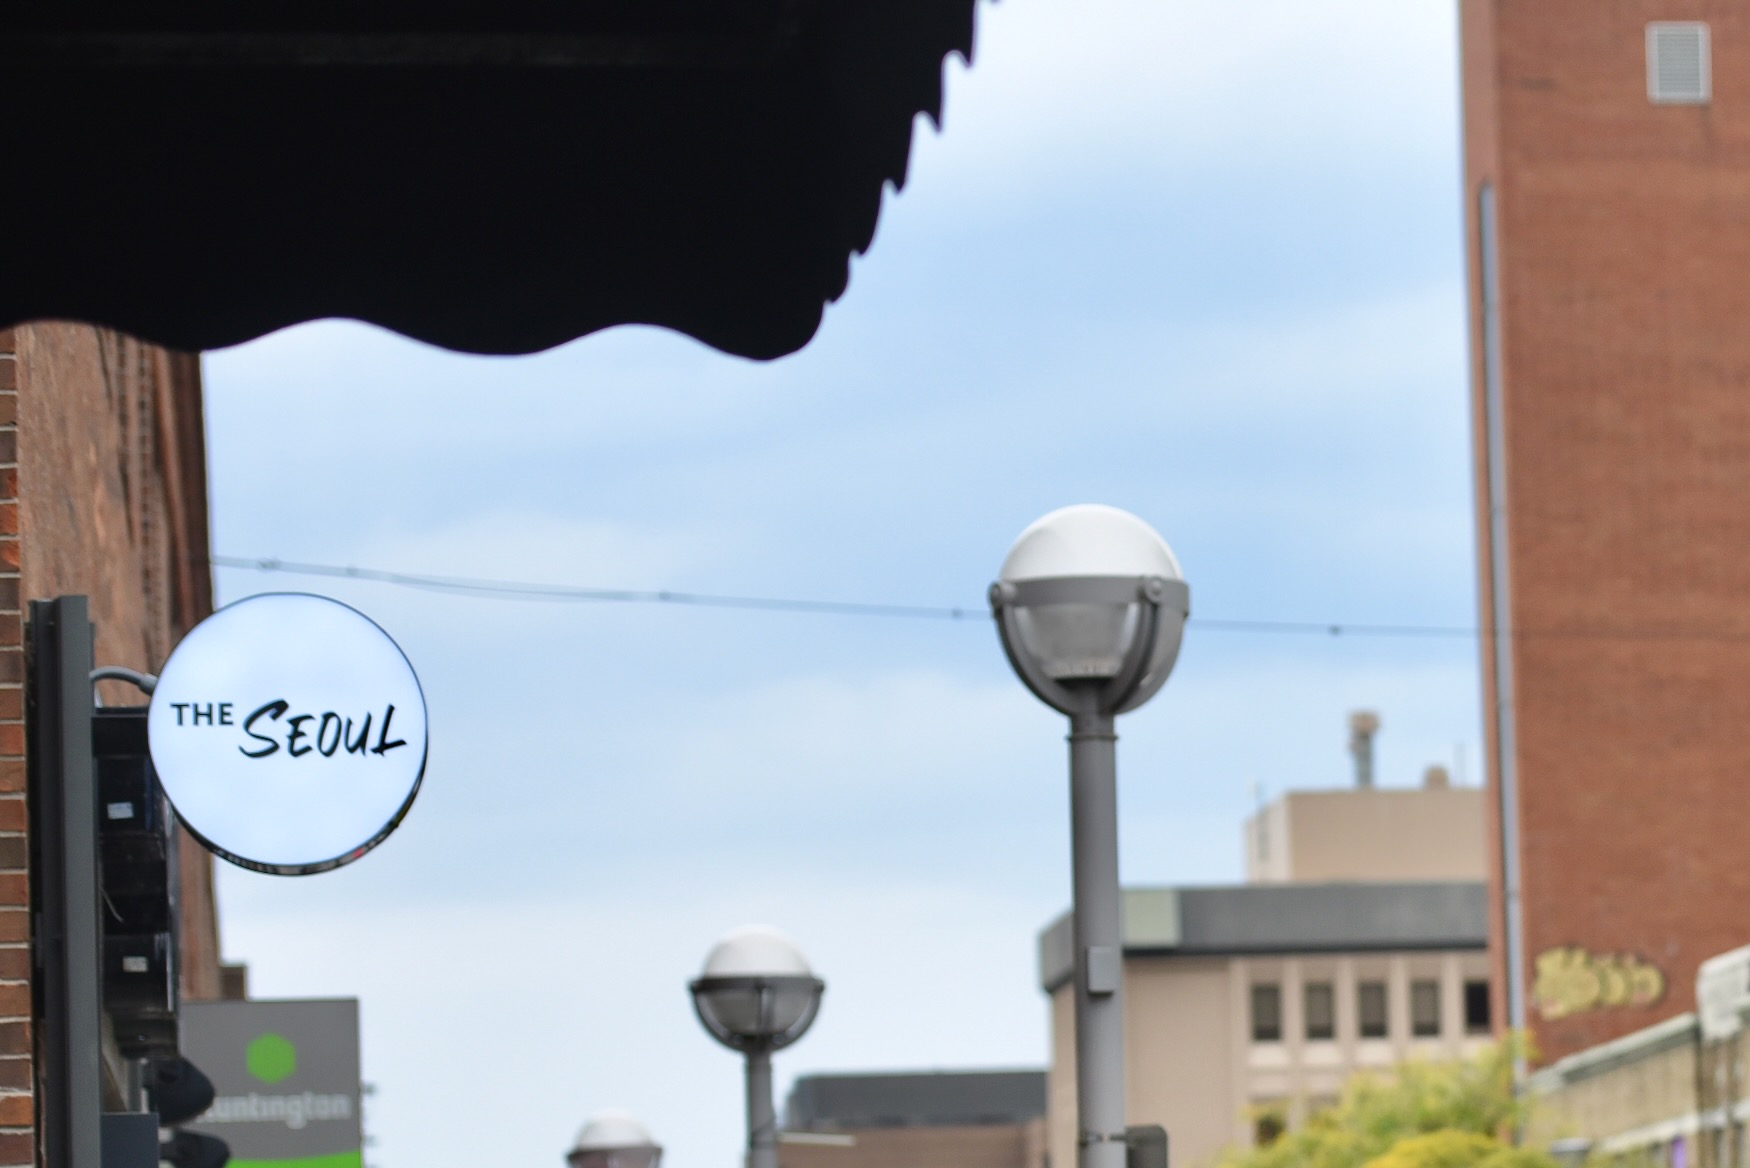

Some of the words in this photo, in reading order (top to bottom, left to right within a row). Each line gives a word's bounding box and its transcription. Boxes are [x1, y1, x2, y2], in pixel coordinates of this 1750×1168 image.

[170, 703, 233, 726] THE
[239, 699, 407, 758] SEOUL
[201, 1091, 349, 1129] untington
